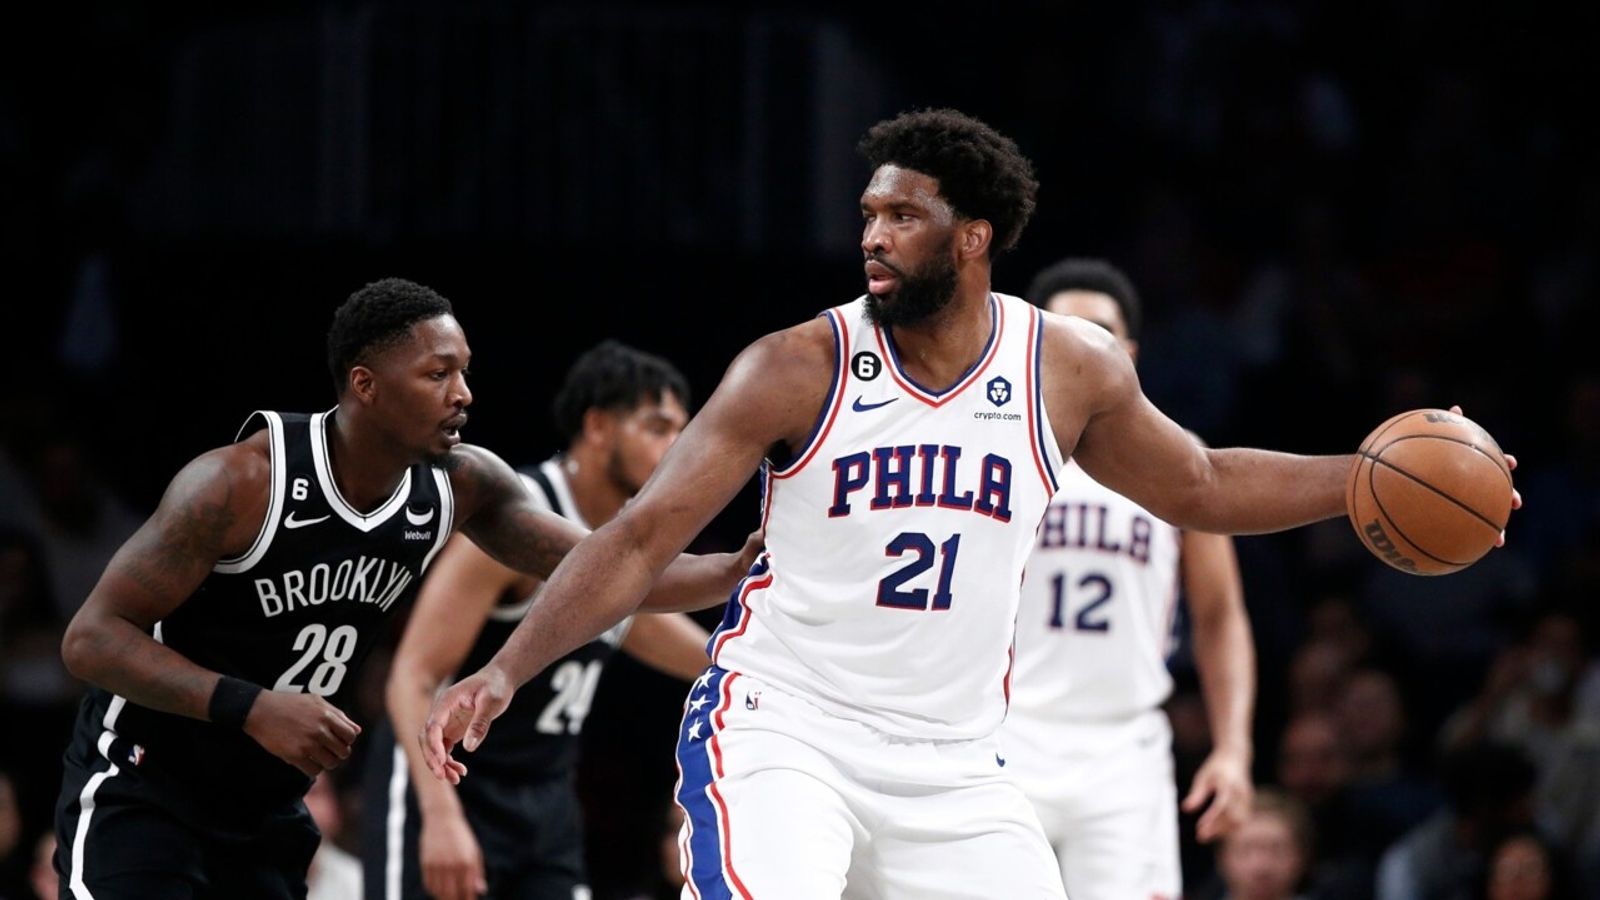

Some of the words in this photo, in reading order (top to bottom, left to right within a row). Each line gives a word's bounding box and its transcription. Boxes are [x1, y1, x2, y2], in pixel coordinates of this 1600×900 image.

[857, 356, 875, 378] 6
[974, 412, 1021, 421] crypto.com
[291, 477, 309, 500] 6
[828, 444, 1012, 523] PHILA
[405, 530, 431, 540] Webull
[1038, 503, 1152, 566] HILA
[254, 555, 413, 618] BROOKLYN
[875, 532, 961, 611] 21
[1047, 571, 1114, 633] 12
[272, 623, 358, 697] 28
[535, 660, 603, 735] 24
